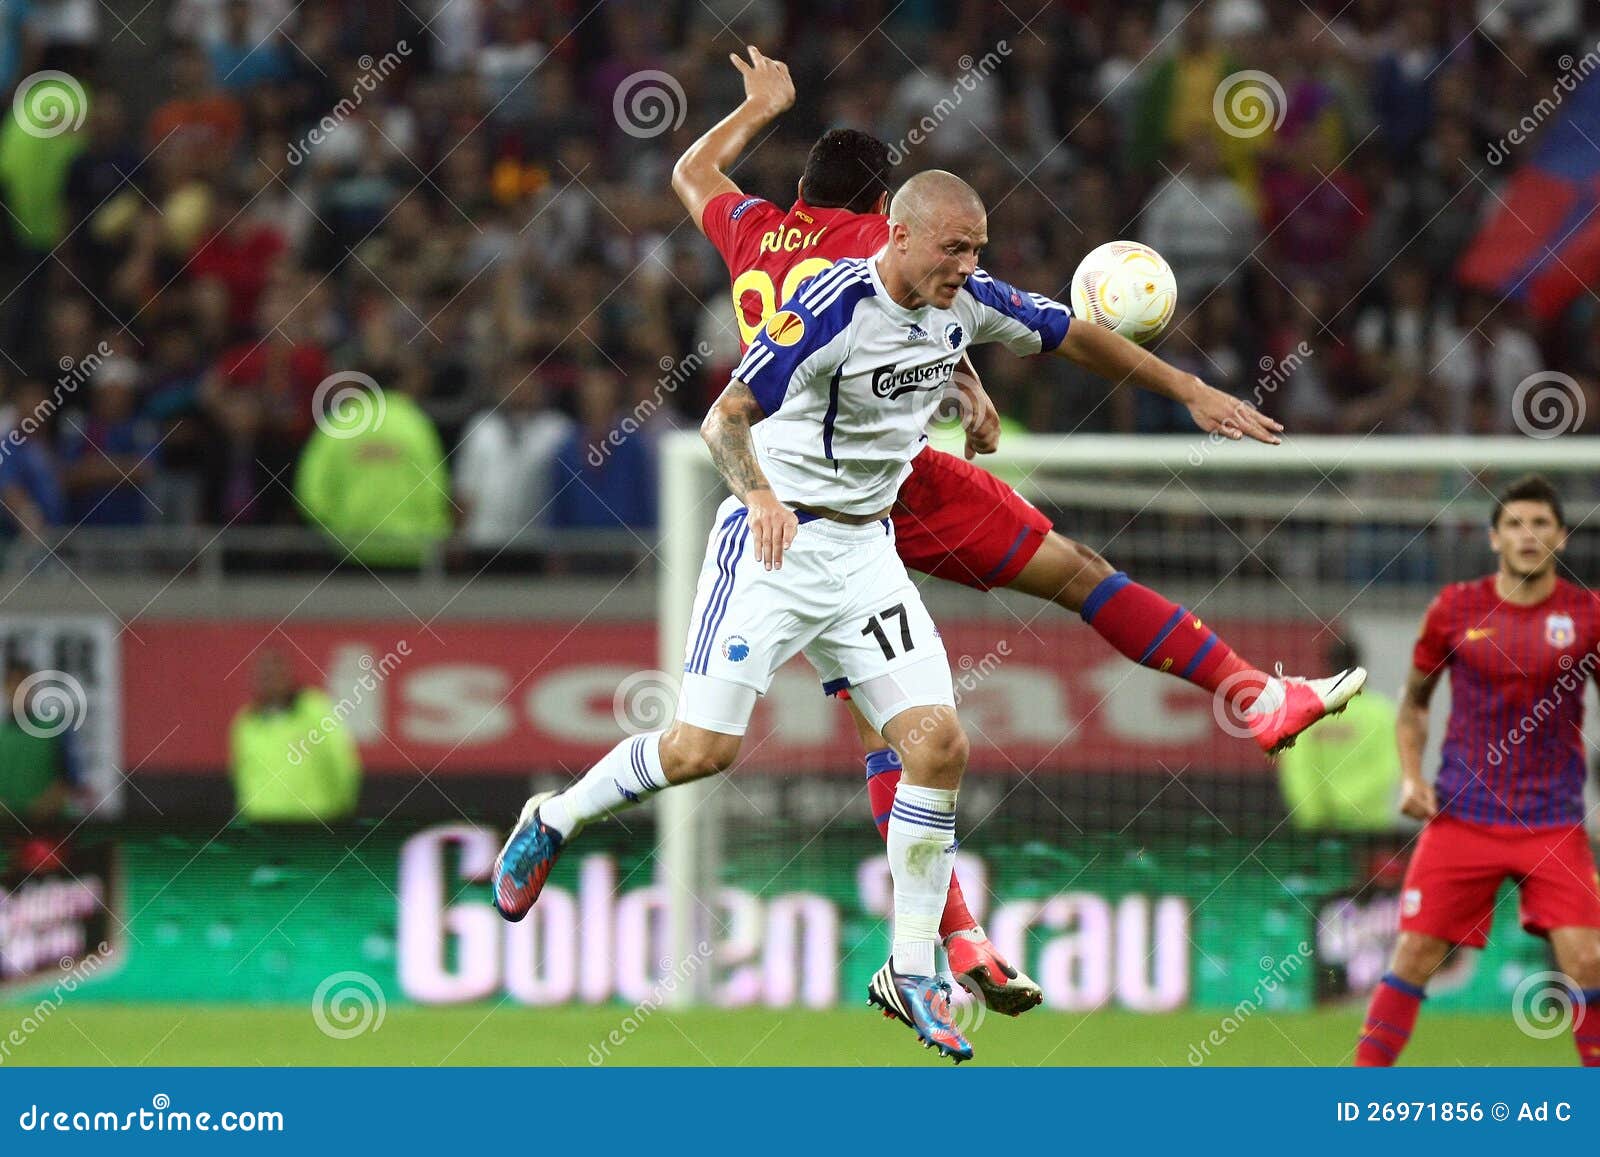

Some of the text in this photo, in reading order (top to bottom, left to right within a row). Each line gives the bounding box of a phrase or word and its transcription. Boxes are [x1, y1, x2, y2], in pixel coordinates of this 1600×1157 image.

[871, 360, 955, 401] Carlsberg
[860, 602, 915, 662] 17
[399, 825, 840, 1010] Golden
